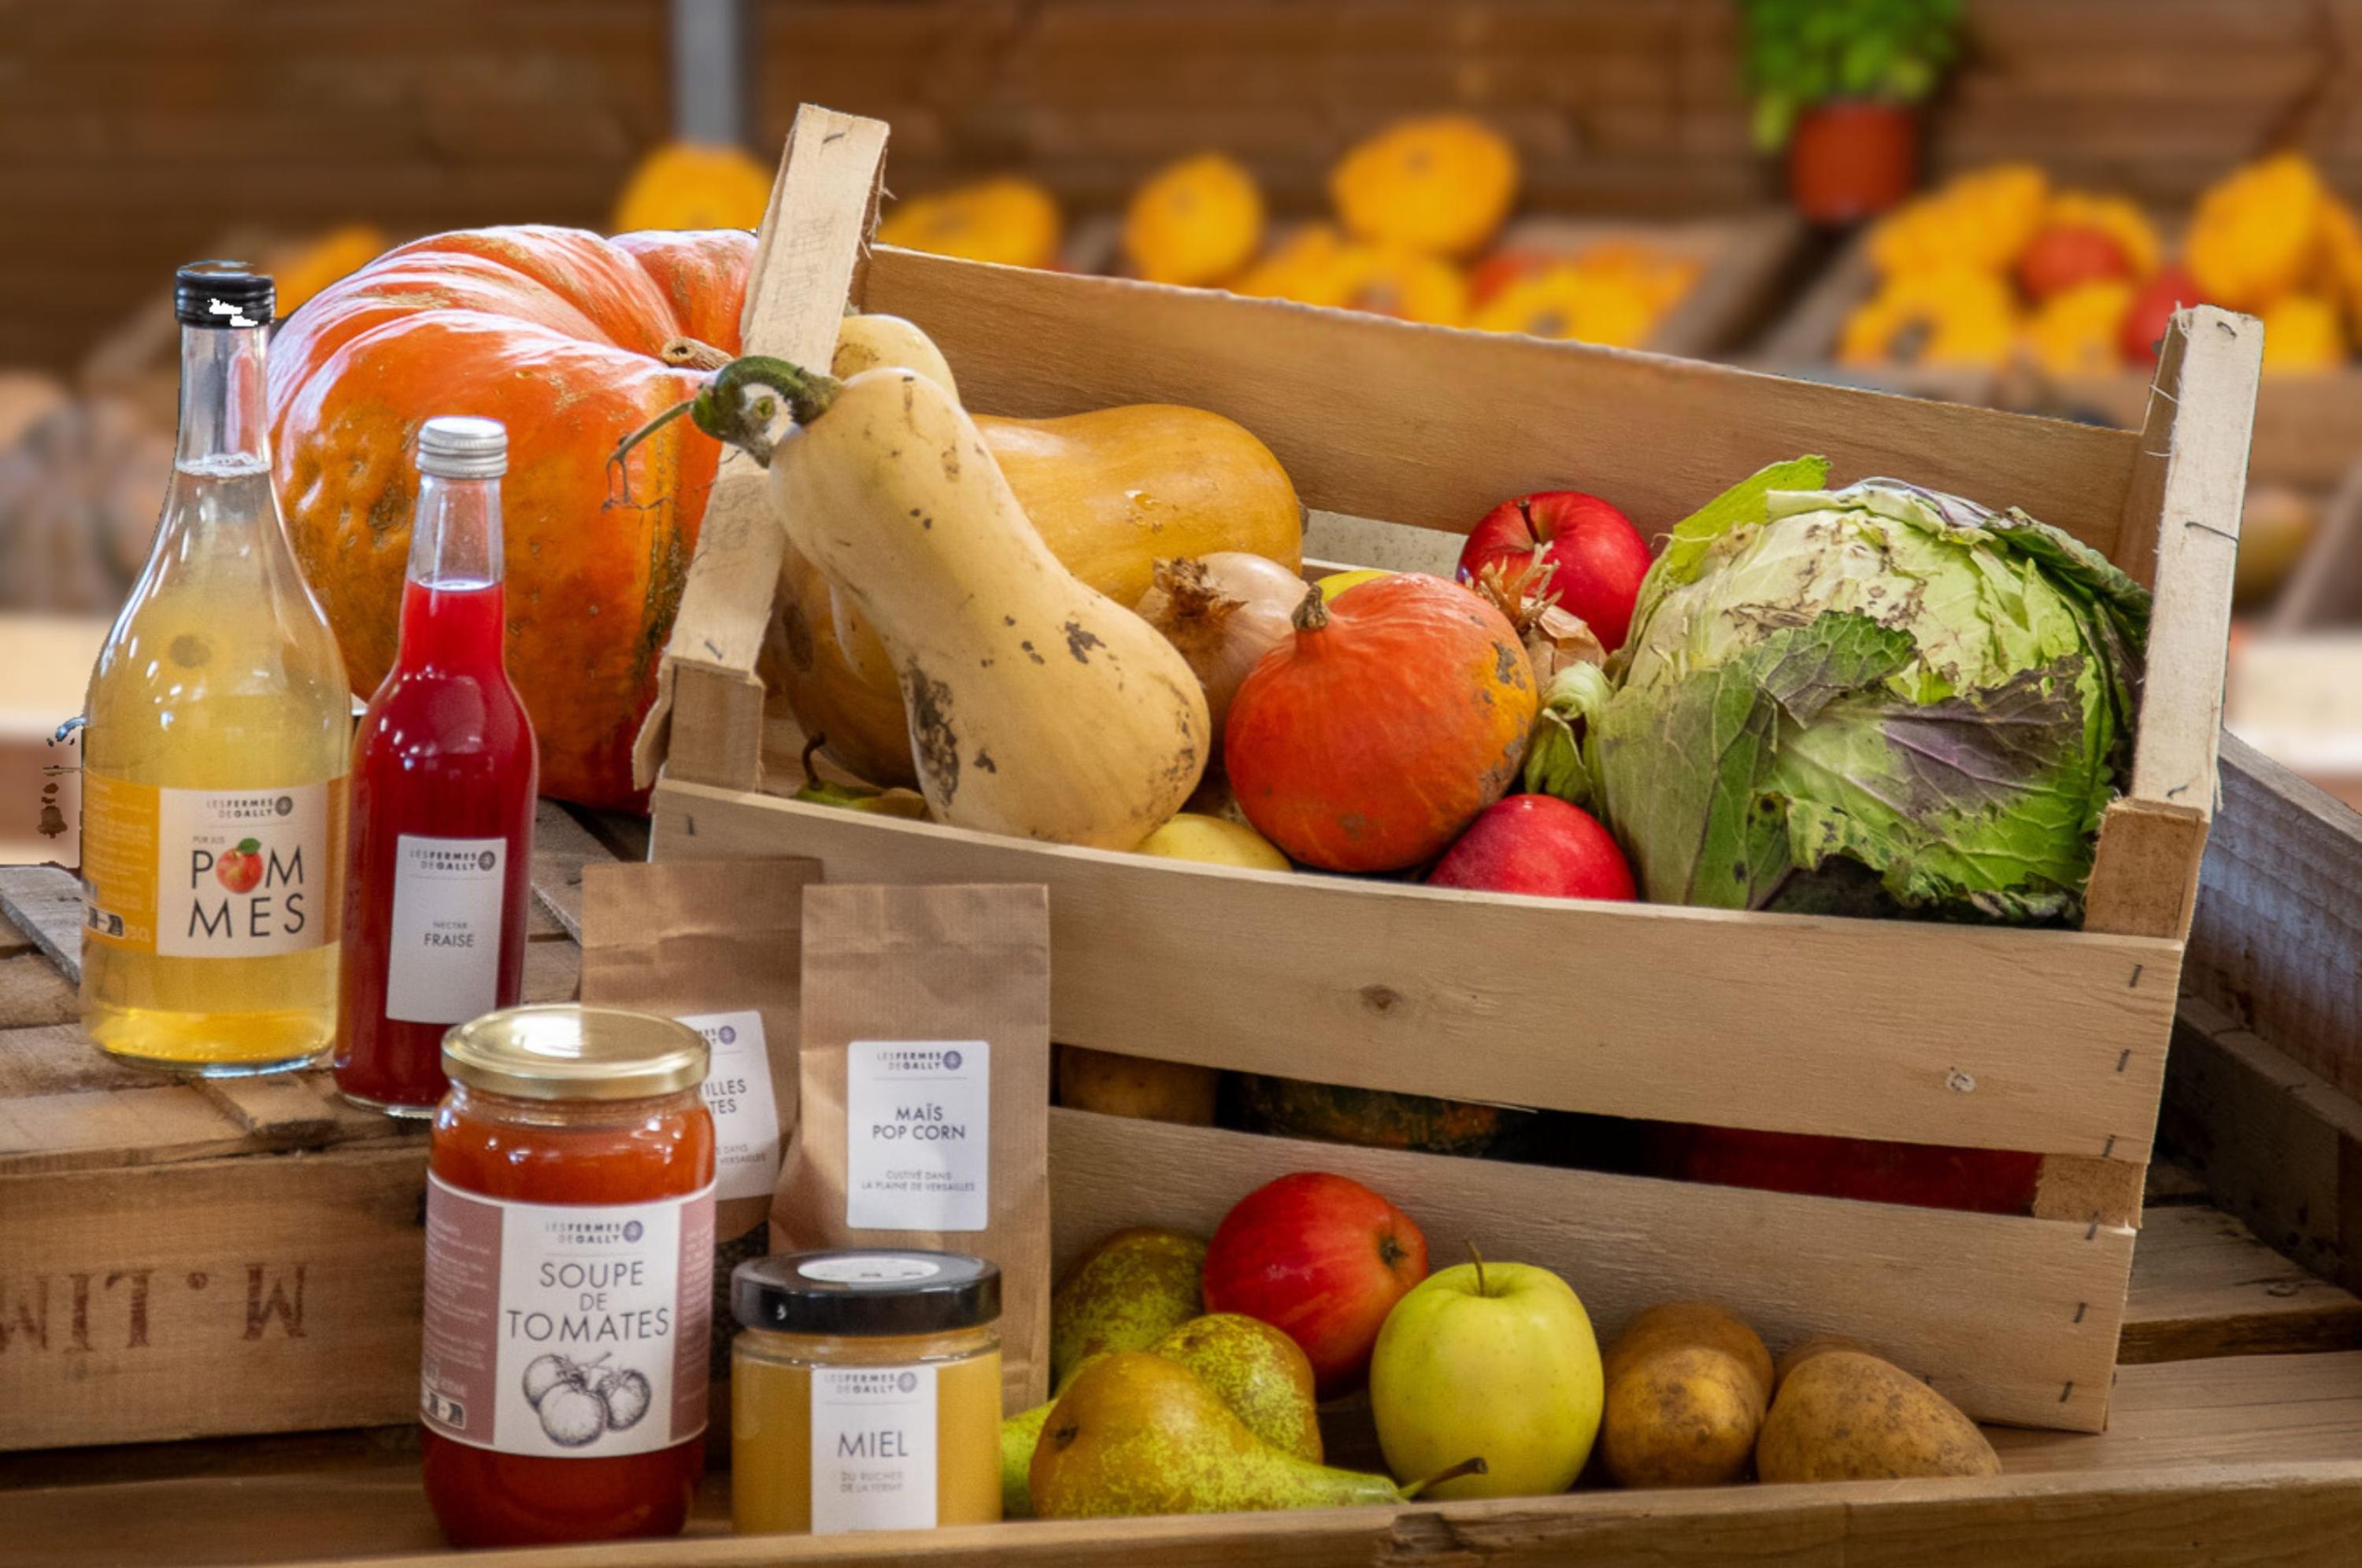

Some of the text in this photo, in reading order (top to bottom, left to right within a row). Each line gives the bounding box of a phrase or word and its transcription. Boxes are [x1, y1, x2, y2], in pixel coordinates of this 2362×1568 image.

[187, 893, 305, 938] MES
[424, 933, 475, 947] FRAISE
[705, 1078, 747, 1096] ILLES
[709, 1099, 737, 1114] TES
[895, 1103, 942, 1121] MAÏS
[872, 1125, 965, 1140] POP CORN
[539, 1261, 644, 1289] SOUPE
[579, 1292, 607, 1311] DE
[506, 1307, 669, 1342] TOMATES
[837, 1431, 909, 1457] MIEL
